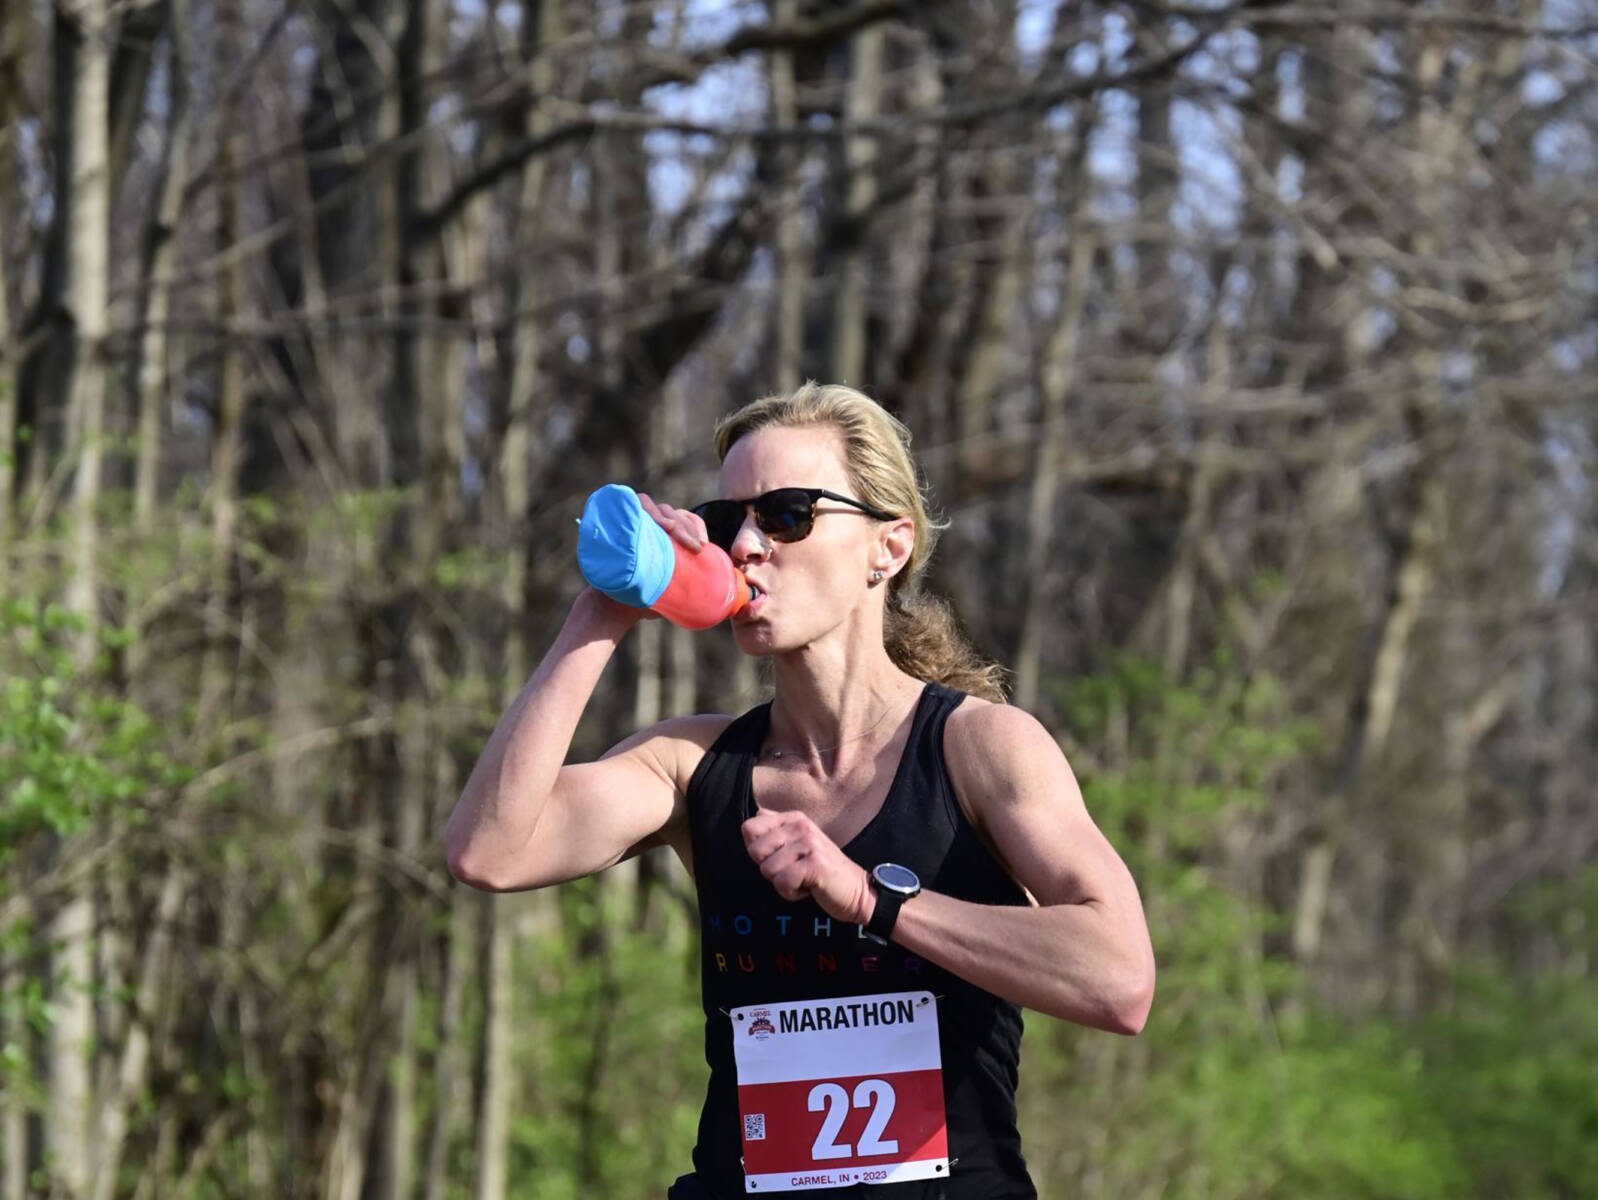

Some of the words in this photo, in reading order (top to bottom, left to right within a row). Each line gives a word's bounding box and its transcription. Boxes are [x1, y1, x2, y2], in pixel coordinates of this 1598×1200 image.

[716, 952, 921, 974] RUNNER
[779, 999, 914, 1033] MARATHON
[807, 1078, 899, 1161] 22
[791, 1175, 837, 1186] CARMEL,
[839, 1173, 850, 1182] IN
[863, 1170, 888, 1181] 2023
